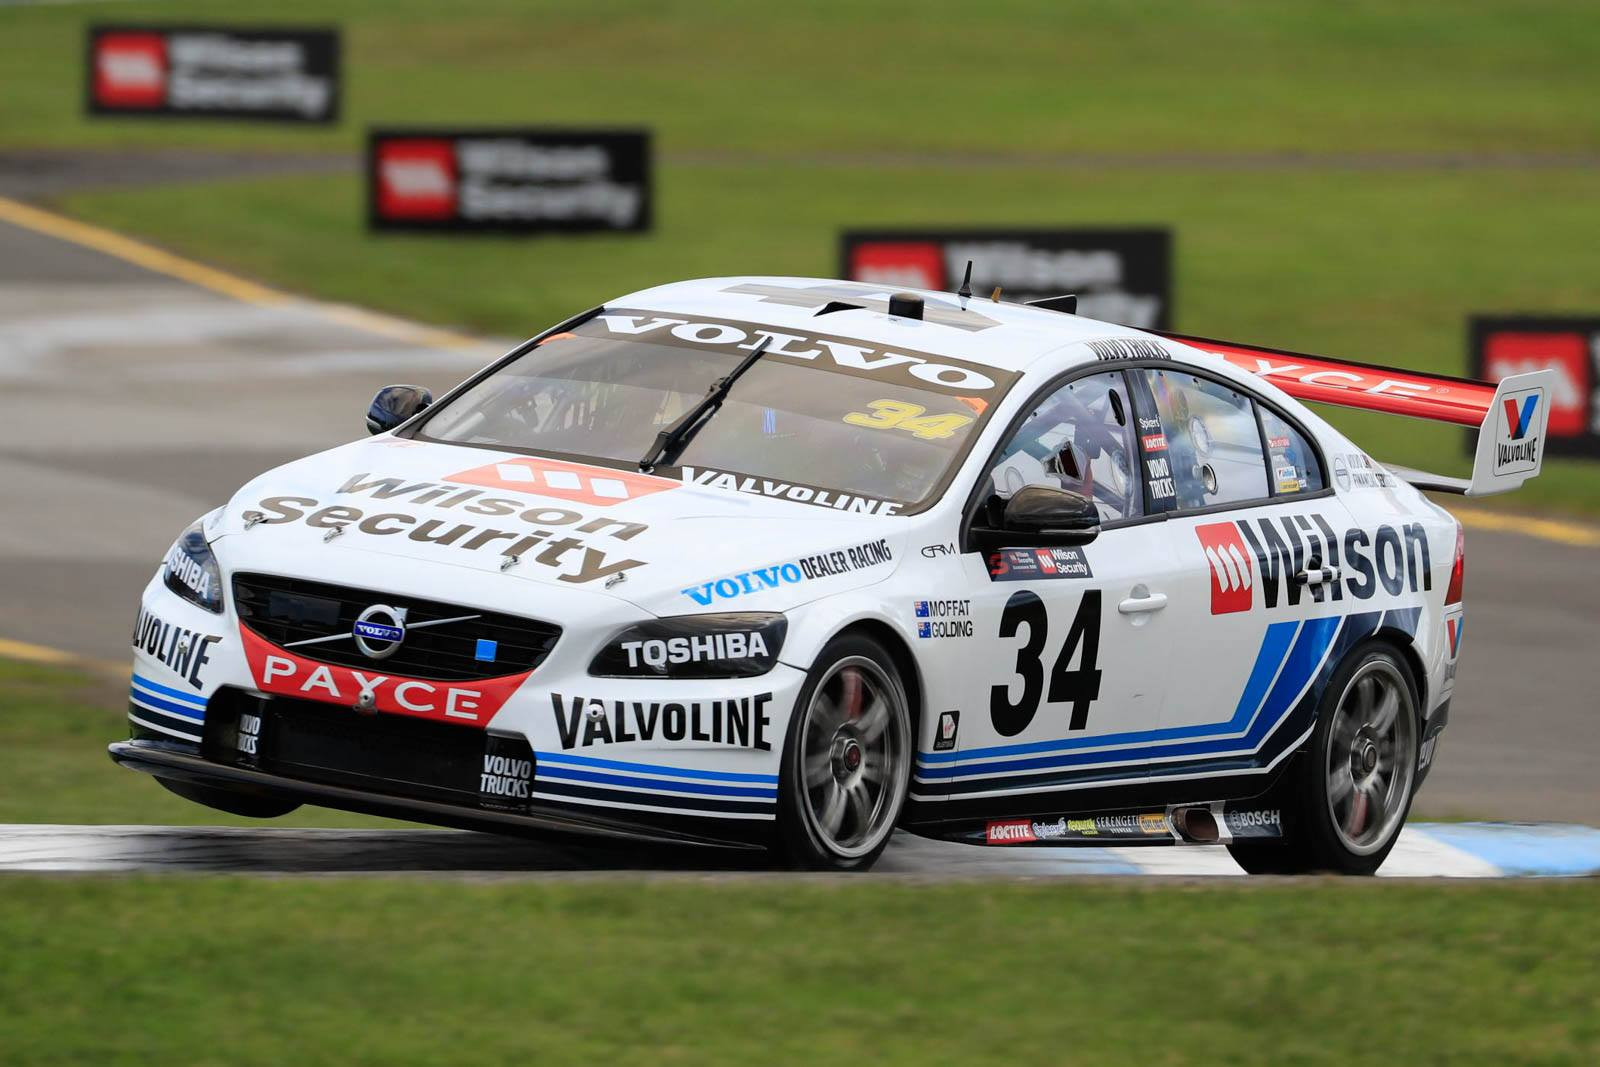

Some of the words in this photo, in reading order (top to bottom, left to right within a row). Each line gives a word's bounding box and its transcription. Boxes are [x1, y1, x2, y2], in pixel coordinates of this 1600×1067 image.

[596, 315, 997, 391] VOLVO
[1208, 353, 1432, 399] YCE
[842, 399, 975, 440] 34
[1497, 437, 1537, 468] VALVOLINE
[336, 473, 649, 541] Wilson
[681, 466, 904, 516] VALVOLINE
[242, 496, 648, 584] Security
[1050, 550, 1078, 560] Wilson
[1236, 513, 1432, 609] Wilson
[166, 547, 211, 599] SHIBA
[681, 563, 801, 607] VOLVO
[799, 550, 850, 580] DEALER
[849, 538, 893, 571] RACING
[1056, 562, 1087, 575] Security
[929, 600, 970, 617] MOFFAT
[931, 620, 973, 638] GOLDING
[133, 607, 223, 691] LVOLINE
[356, 624, 400, 638] VOLVO
[621, 632, 770, 668] TOSHIBA
[989, 589, 1102, 737] 34
[262, 655, 483, 721] PAYCE
[551, 692, 773, 751] VALVOLINE
[480, 774, 531, 799] TRUCKS
[484, 755, 531, 779] VOLVO
[990, 824, 1030, 840] LOCTITE
[1240, 811, 1281, 827] BOSCH
